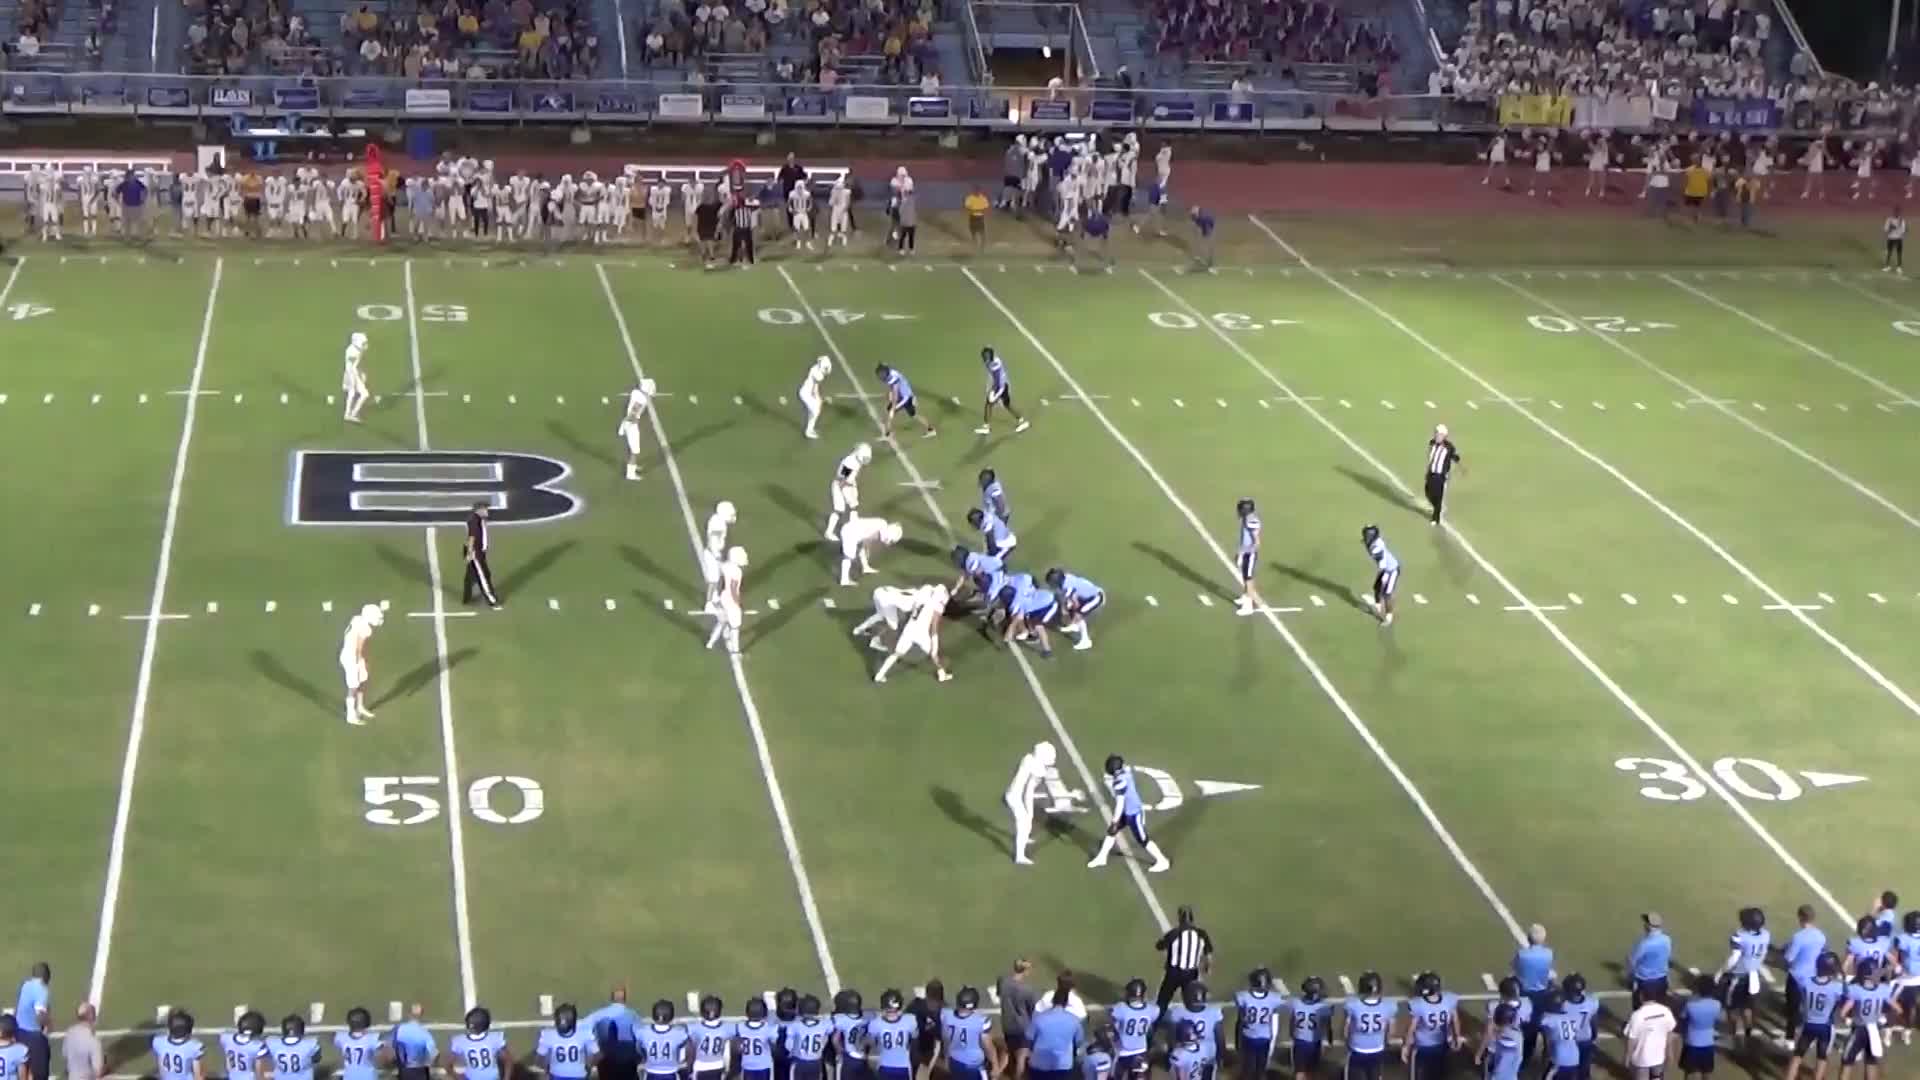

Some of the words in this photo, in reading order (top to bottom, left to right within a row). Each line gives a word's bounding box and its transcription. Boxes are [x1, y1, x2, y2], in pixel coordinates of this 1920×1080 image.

[357, 304, 468, 321] 50
[757, 307, 866, 324] 40
[1147, 311, 1264, 329] 30
[1527, 315, 1640, 332] 20
[288, 450, 581, 524] B
[1614, 757, 1802, 800] 30
[364, 775, 544, 825] 50
[1809, 991, 1826, 1012] 16
[1125, 1017, 1148, 1037] 83
[1296, 1011, 1318, 1031] 25
[1361, 1013, 1382, 1033] 55
[650, 1040, 671, 1060] 44
[700, 1035, 722, 1055] 48
[800, 1033, 821, 1053] 46
[882, 1031, 904, 1050] 84
[162, 1052, 184, 1074] 49
[277, 1053, 301, 1073] 58
[344, 1046, 364, 1066] 47
[468, 1047, 493, 1069] 68
[556, 1044, 579, 1063] 60
